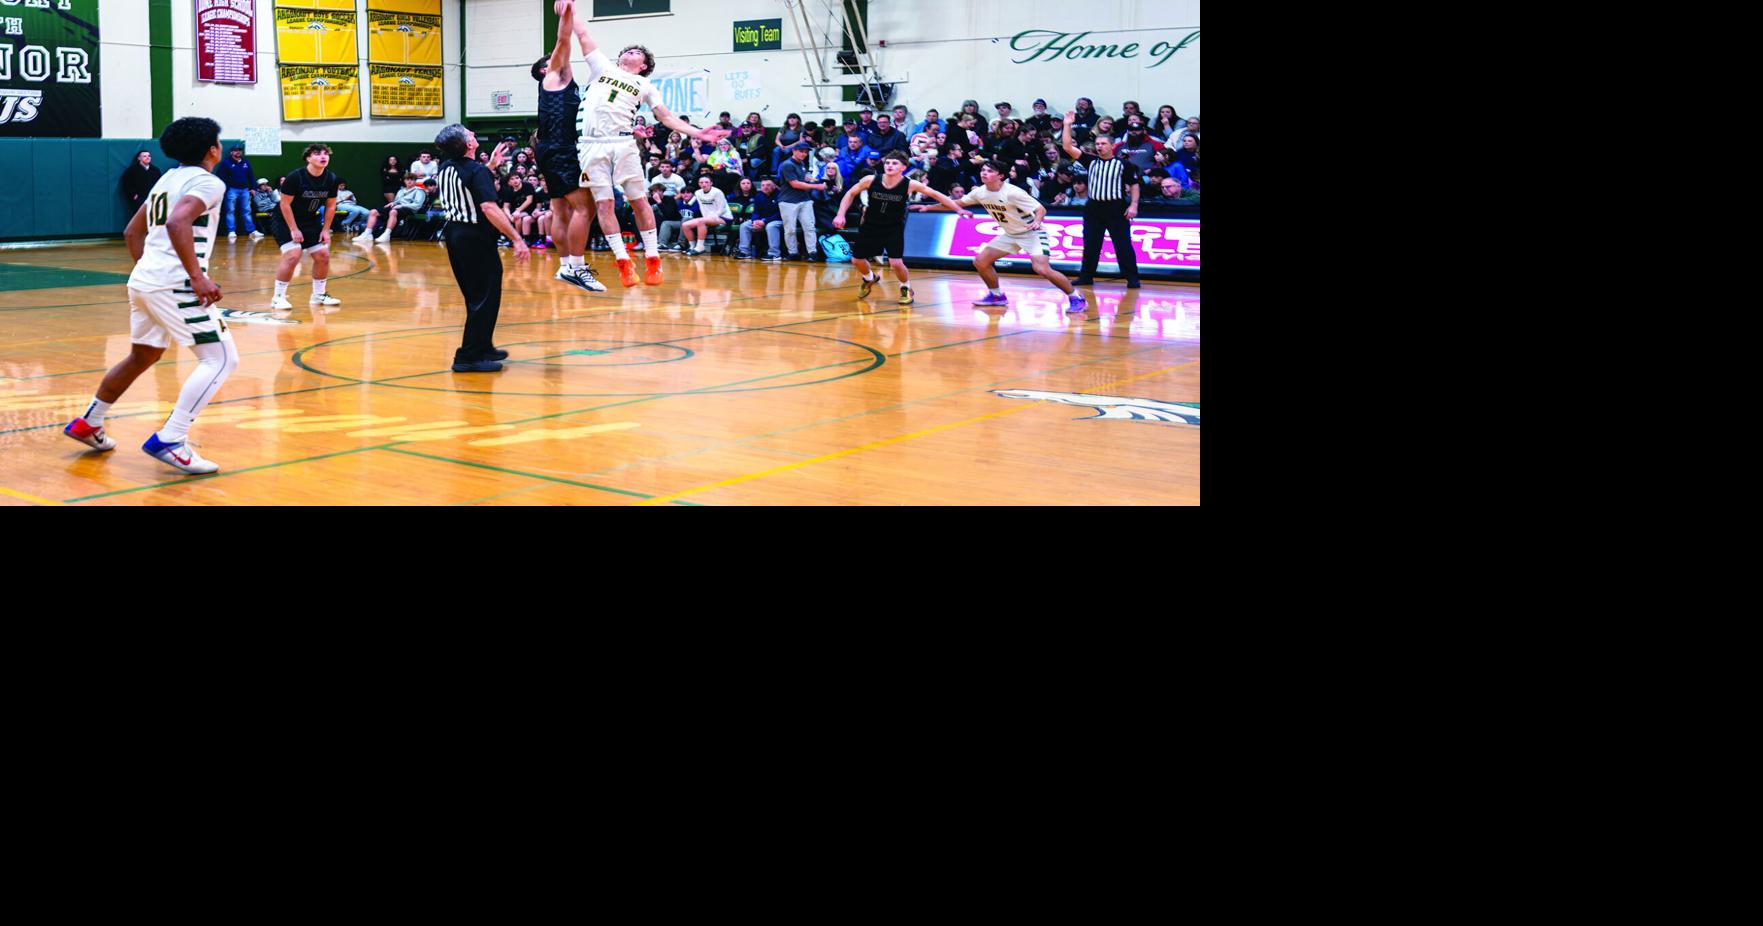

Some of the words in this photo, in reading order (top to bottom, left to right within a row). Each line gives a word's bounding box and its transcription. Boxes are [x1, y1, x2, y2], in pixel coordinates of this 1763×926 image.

[734, 26, 759, 47] Visiting
[759, 25, 780, 42] Team
[1009, 29, 1139, 64] Home
[1144, 30, 1200, 69] of
[598, 75, 640, 96] STANGS
[608, 89, 619, 103] 1
[581, 172, 590, 182] A
[149, 192, 168, 227] 10
[992, 211, 1008, 223] 12
